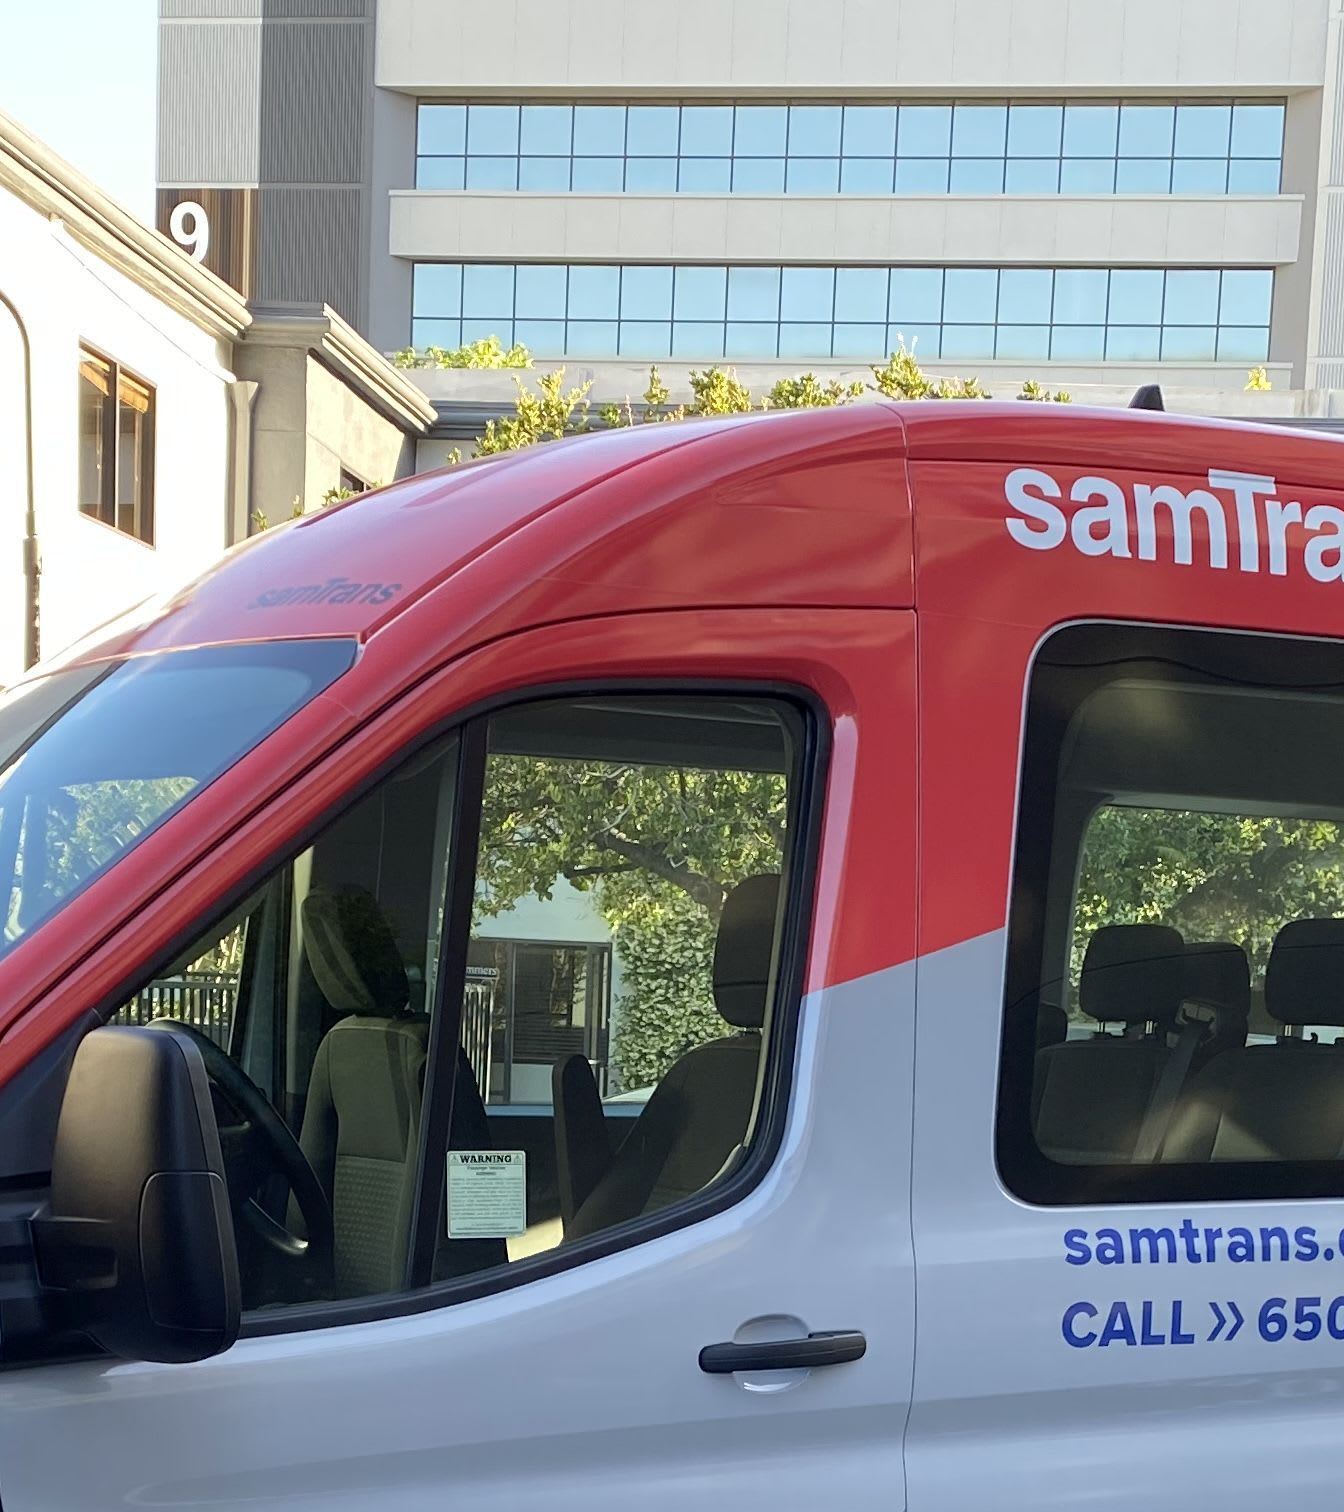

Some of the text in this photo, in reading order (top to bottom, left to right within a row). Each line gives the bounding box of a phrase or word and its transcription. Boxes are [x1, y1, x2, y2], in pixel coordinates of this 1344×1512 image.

[169, 201, 209, 263] 9
[248, 576, 402, 610] samTrans
[459, 1154, 512, 1164] WARNING
[1061, 1300, 1195, 1348] CALL
